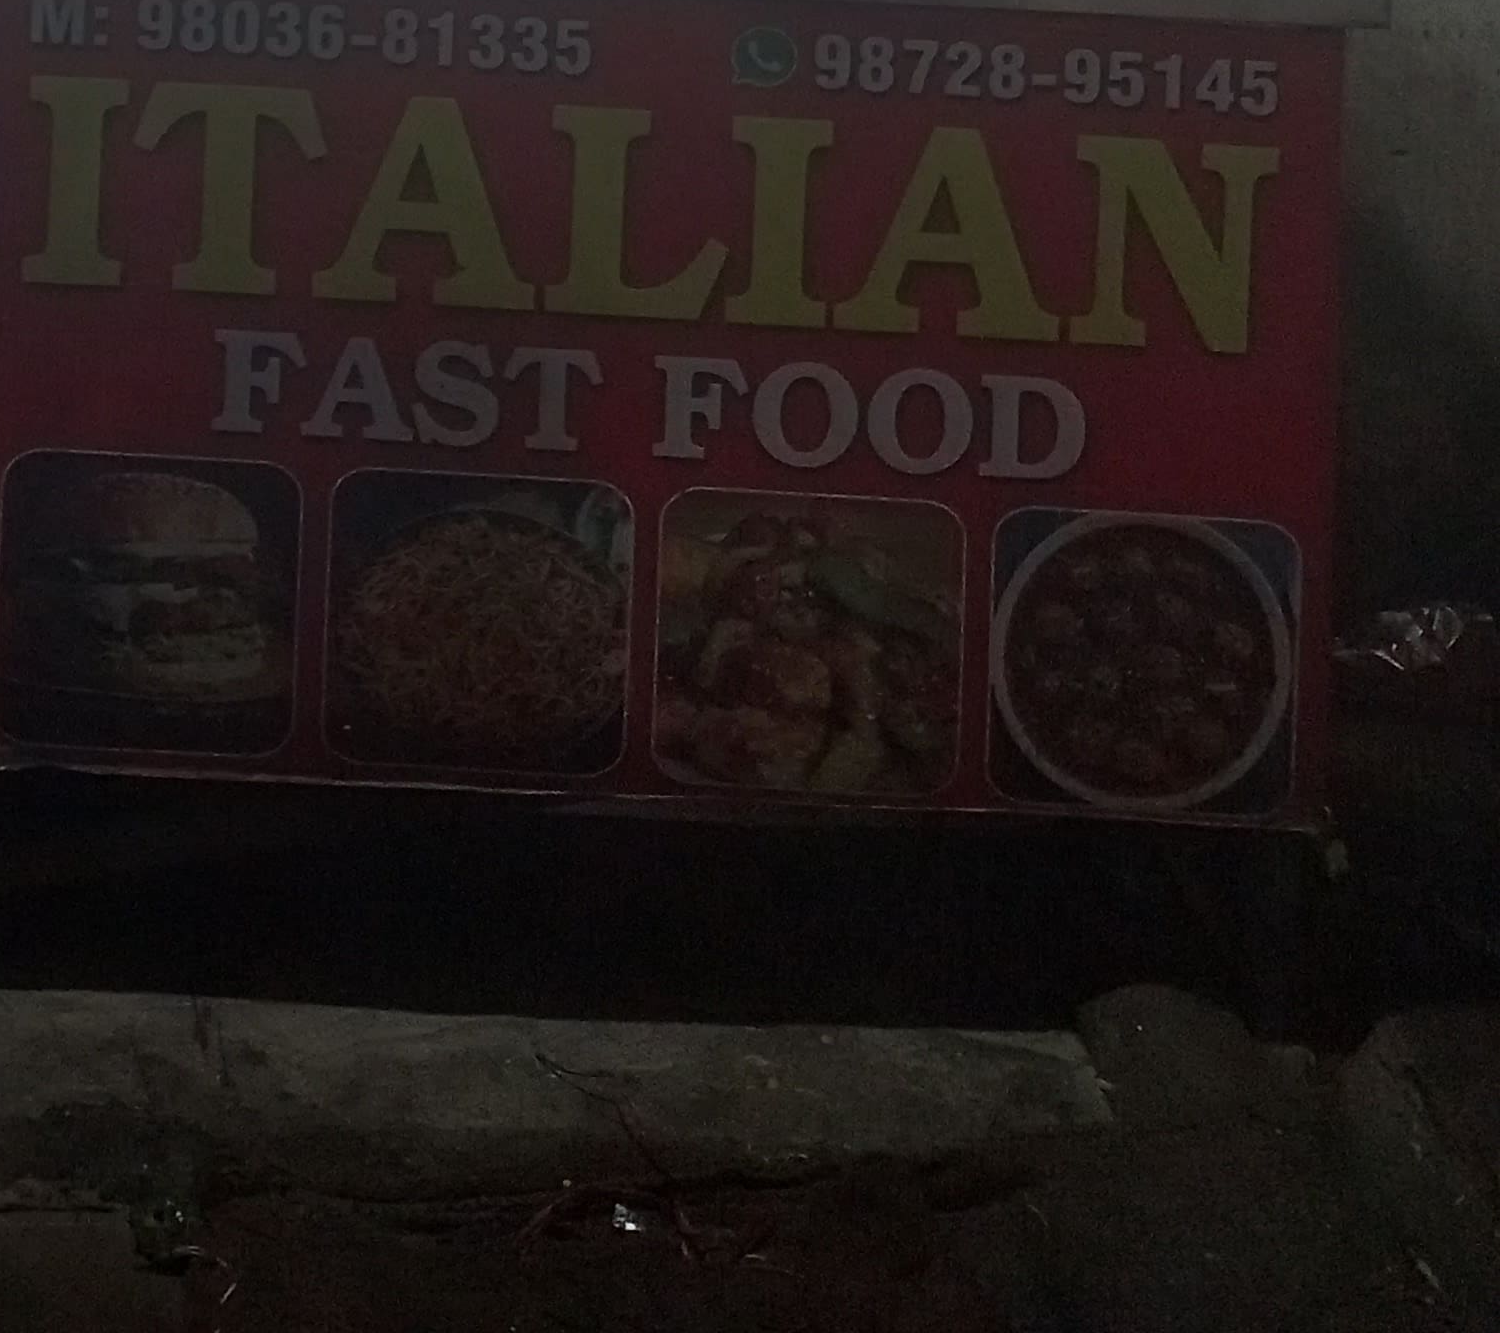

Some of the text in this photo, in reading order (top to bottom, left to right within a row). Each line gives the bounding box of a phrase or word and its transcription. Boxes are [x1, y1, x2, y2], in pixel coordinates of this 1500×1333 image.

[812, 33, 1281, 118] 98728-95145
[21, 74, 1282, 357] ITALIAN
[212, 330, 1088, 482] FAST FOOD
